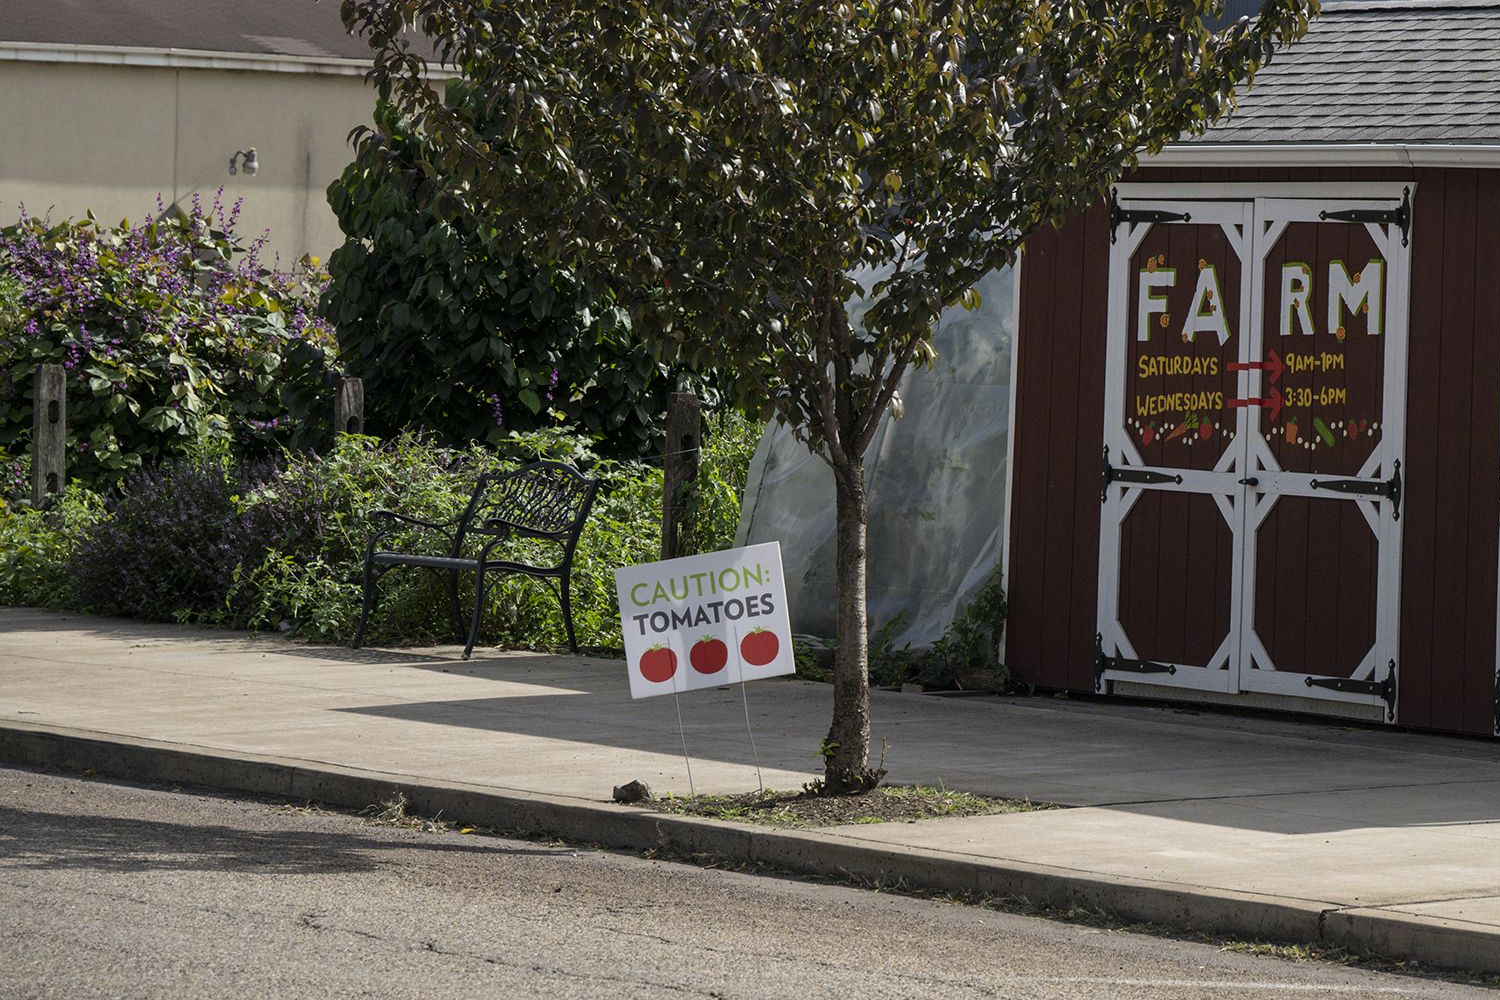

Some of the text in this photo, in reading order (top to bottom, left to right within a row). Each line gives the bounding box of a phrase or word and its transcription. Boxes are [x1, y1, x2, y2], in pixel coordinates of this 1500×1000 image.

[1137, 258, 1383, 346] FARM
[1138, 352, 1344, 378] SATURDAYS 9AM-1PM
[1136, 386, 1346, 416] WEDNESDAYS 3:30-6PM
[630, 563, 770, 607] CAUTION:
[633, 593, 775, 636] TOMATOES
